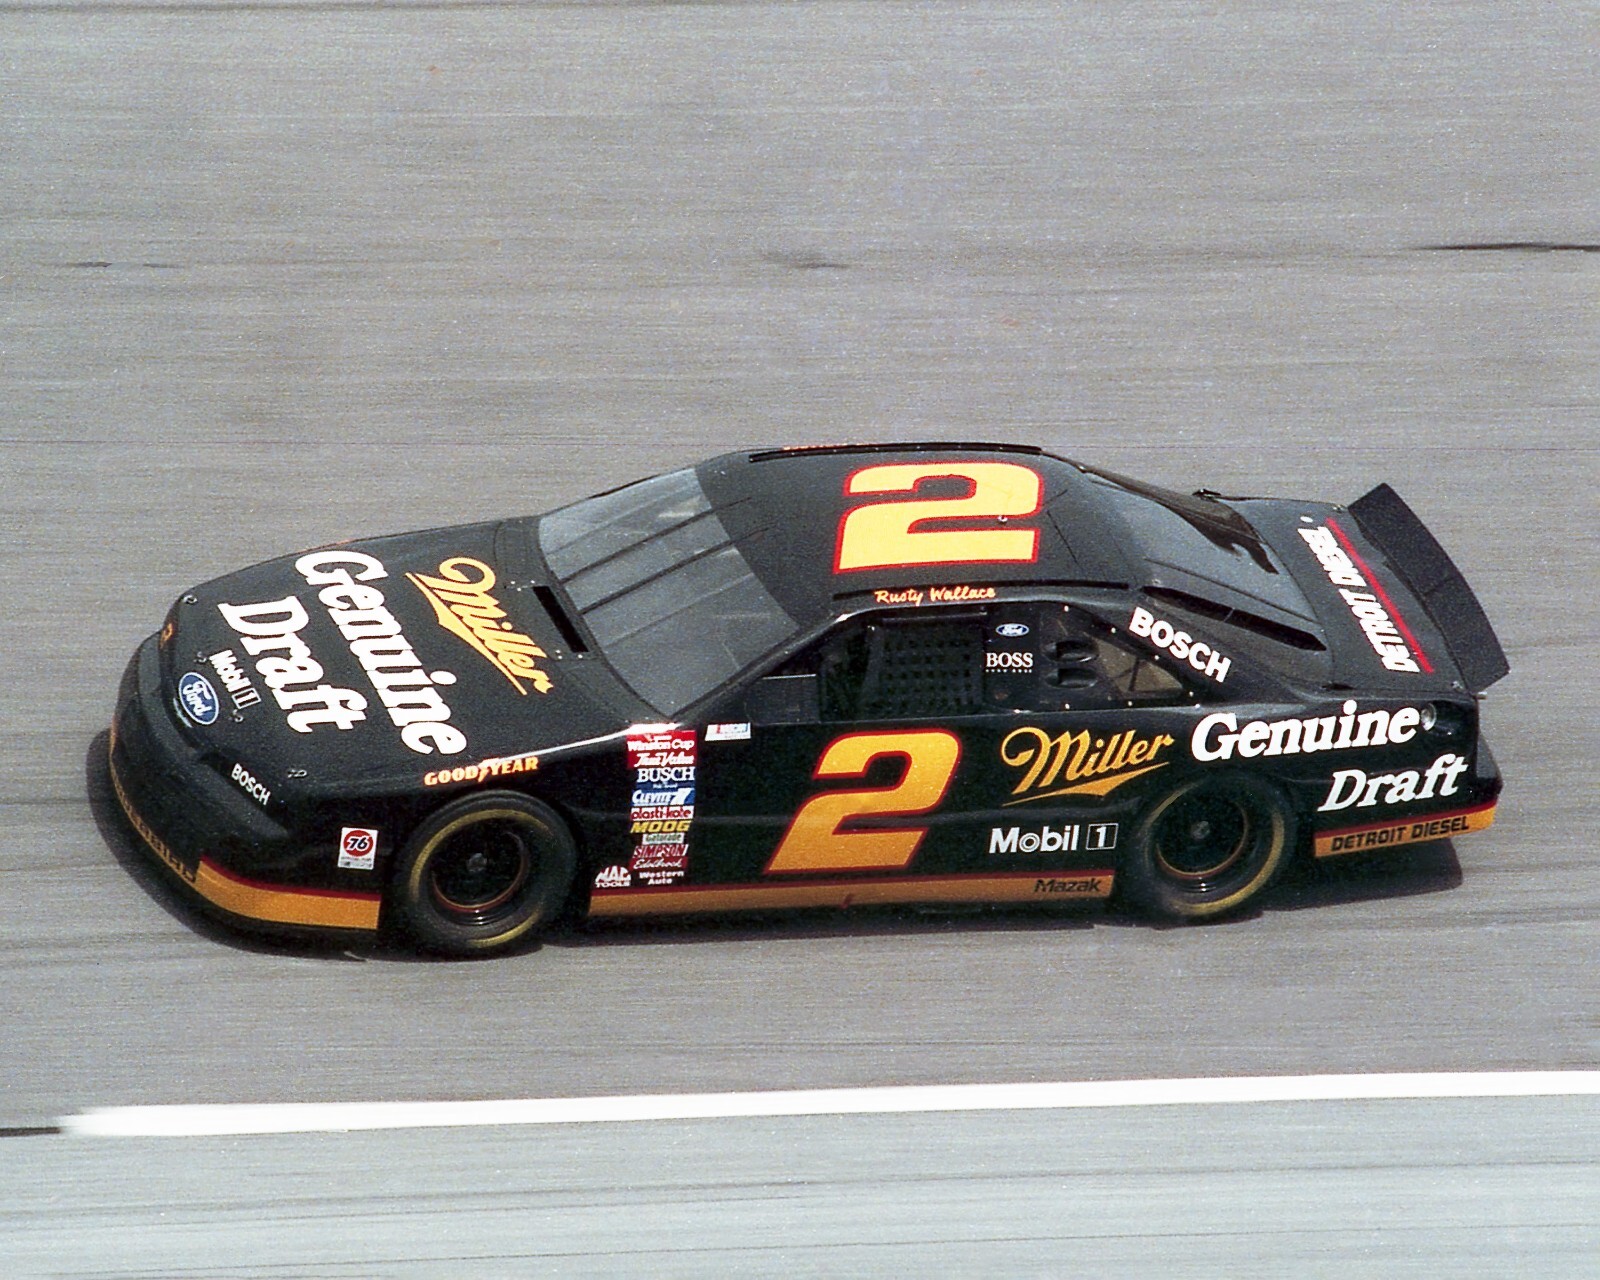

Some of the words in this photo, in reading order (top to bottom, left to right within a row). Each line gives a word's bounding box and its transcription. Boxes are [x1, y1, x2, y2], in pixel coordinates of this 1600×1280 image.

[833, 460, 1045, 575] 2
[873, 588, 924, 607] Rusty
[930, 586, 997, 602] Wallace
[414, 556, 555, 695] Miller
[295, 550, 467, 755] Genuine
[986, 652, 1034, 668] BOSS
[1128, 606, 1233, 684] BOSCH
[209, 649, 252, 693] Mobil
[217, 595, 368, 734] Draft
[182, 680, 213, 717] Ford
[1191, 699, 1420, 763] Genuine
[423, 756, 539, 786] GOODYEAR
[637, 766, 696, 782] BUSCH
[1000, 726, 1175, 795] Miller
[231, 762, 271, 806] BOSCH
[1317, 753, 1469, 812] Draft
[763, 728, 963, 876] 2
[347, 836, 369, 850] 76
[629, 820, 692, 834] MOOG
[989, 824, 1080, 854] Mobil
[1331, 826, 1406, 851] DETROIT
[1411, 816, 1470, 839] DIESEL
[639, 870, 685, 879] Western
[647, 878, 673, 886] Auto
[1033, 878, 1103, 894] Mazak
